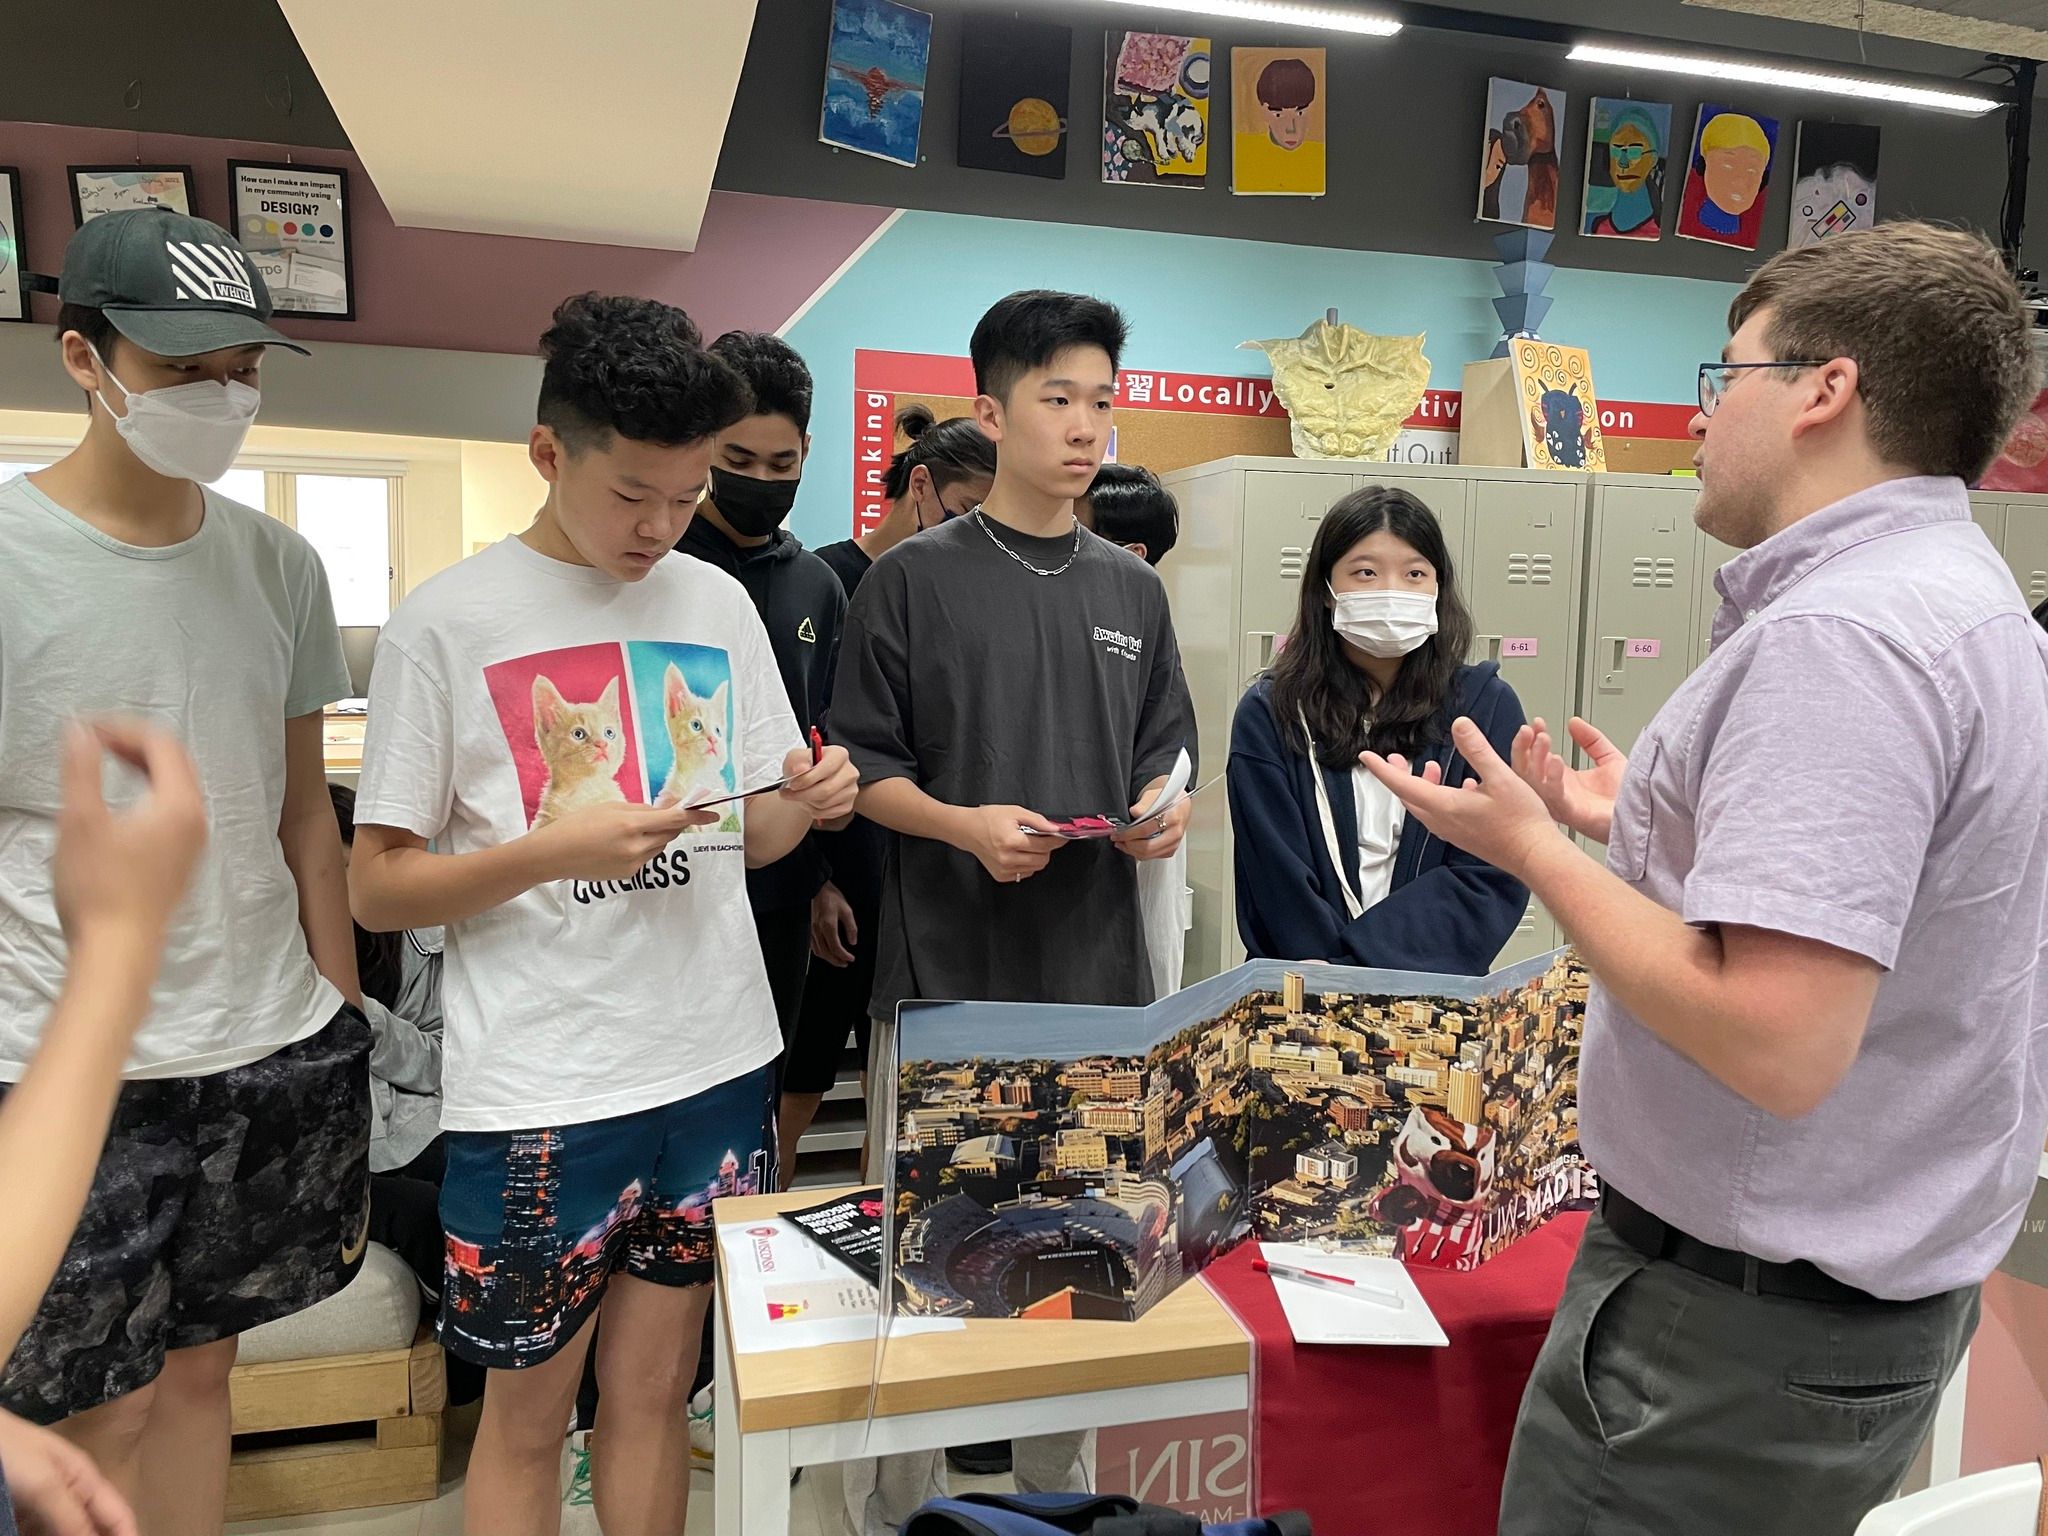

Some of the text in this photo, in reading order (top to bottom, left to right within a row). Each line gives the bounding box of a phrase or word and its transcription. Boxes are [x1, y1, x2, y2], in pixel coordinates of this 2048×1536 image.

[241, 175, 257, 183] How
[277, 178, 298, 186] make
[309, 180, 336, 190] impact
[254, 187, 266, 195] my
[267, 188, 309, 199] community
[310, 190, 331, 201] using
[260, 200, 319, 216] DESIGN?
[215, 282, 250, 303] WHITE
[1114, 373, 1153, 403] 習
[1159, 376, 1274, 415] Locally
[1411, 393, 1459, 419] tiv
[1407, 442, 1453, 465] Out
[860, 393, 889, 538] Thinking
[1511, 642, 1528, 651] 6-61
[1634, 644, 1652, 653] 6-60
[794, 1202, 857, 1223] WISCONSIN
